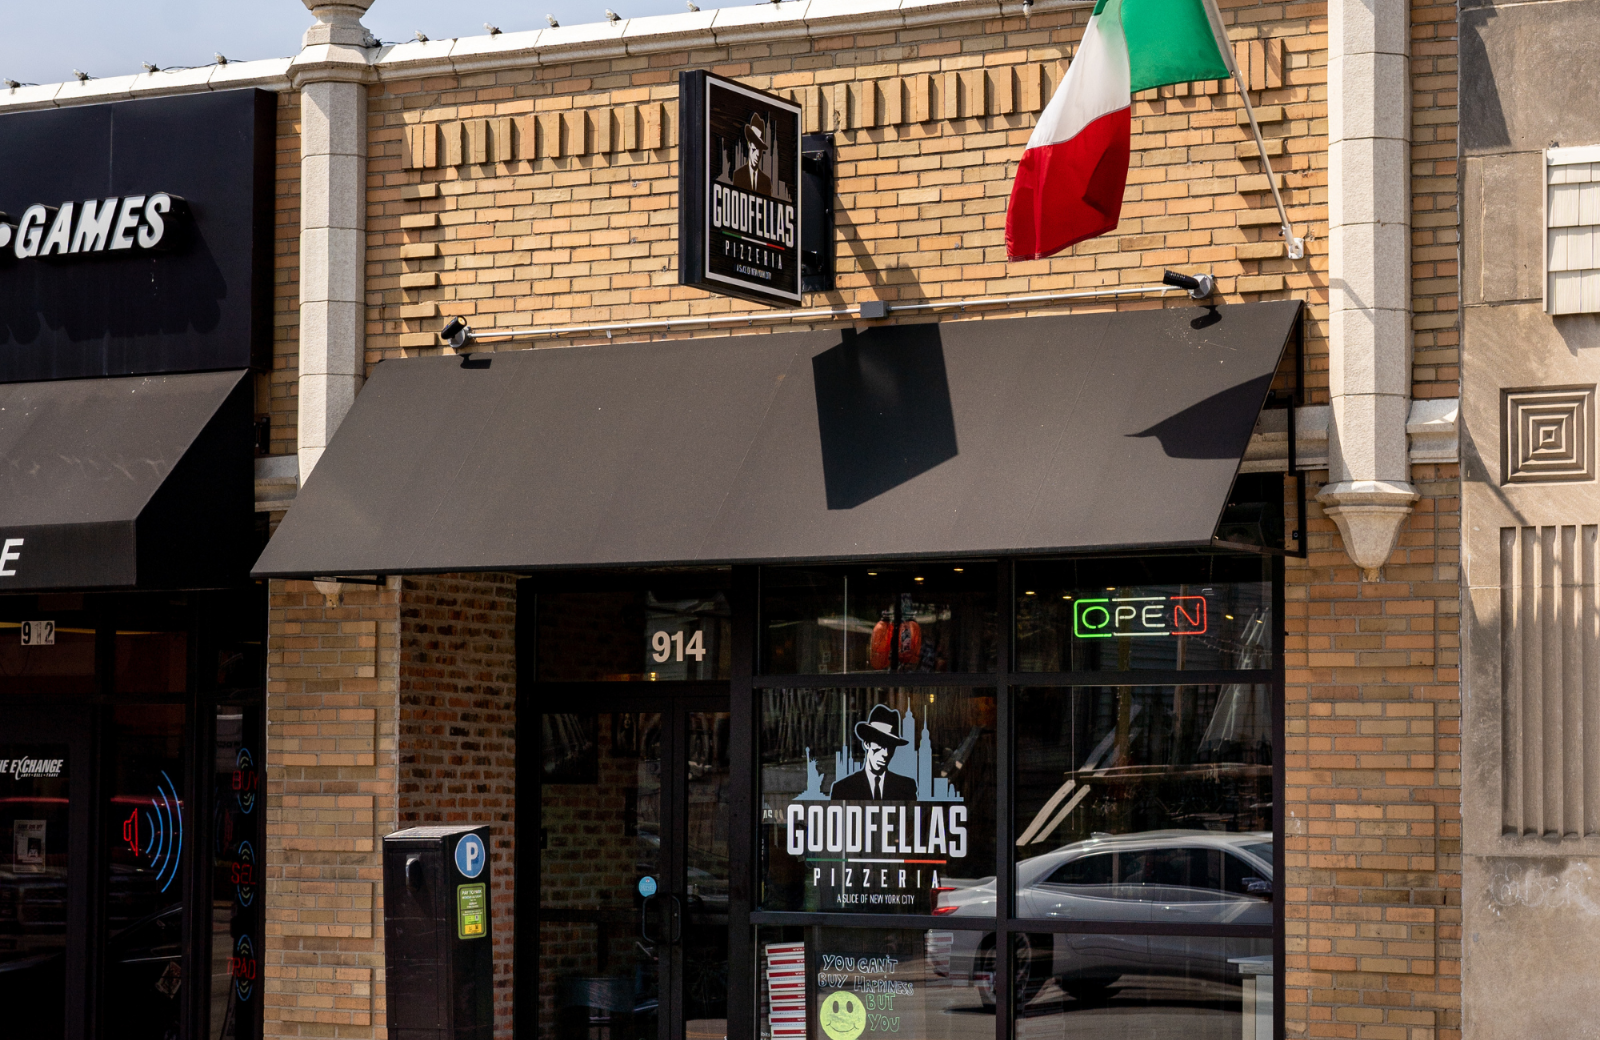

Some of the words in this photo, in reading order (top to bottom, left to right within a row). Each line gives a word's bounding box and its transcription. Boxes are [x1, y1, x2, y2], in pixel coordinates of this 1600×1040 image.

[15, 192, 171, 258] GAMES
[713, 183, 794, 248] GOODFELLAS
[725, 240, 783, 270] PIZZERIA
[1080, 603, 1201, 630] OPEN
[652, 631, 706, 662] 914
[9, 756, 64, 781] EXCHANGE
[232, 770, 259, 791] BUY
[787, 804, 968, 858] GOODFELLAS
[813, 868, 940, 889] PIZZERIA
[836, 894, 842, 903] A
[842, 894, 859, 904] SLICE
[860, 894, 868, 904] OF
[869, 894, 884, 904] NEW
[884, 894, 901, 905] YORK
[901, 894, 915, 905] CITY
[822, 954, 855, 971] YOU
[817, 972, 849, 988] BUY
[865, 992, 896, 1011] BUT
[867, 1013, 900, 1033] YOU
